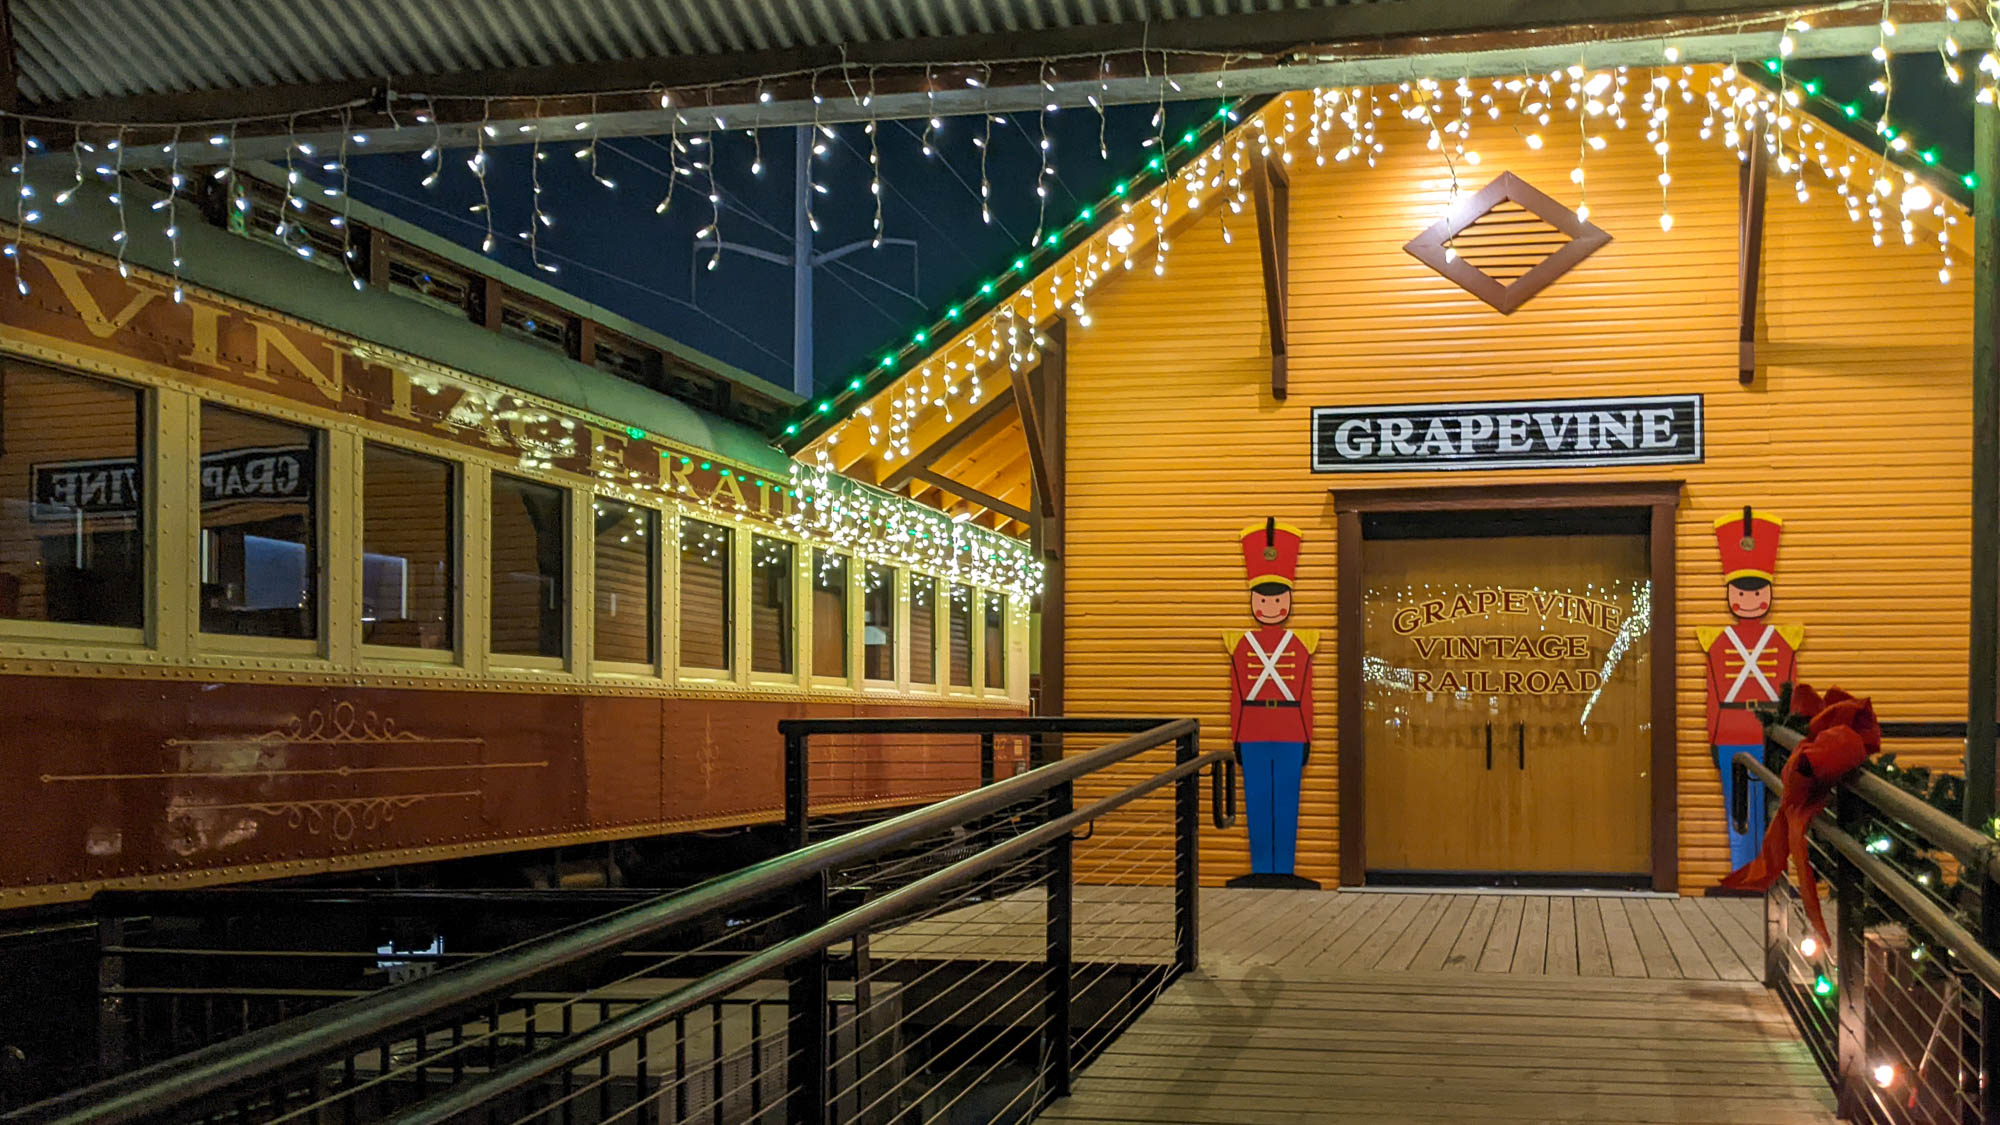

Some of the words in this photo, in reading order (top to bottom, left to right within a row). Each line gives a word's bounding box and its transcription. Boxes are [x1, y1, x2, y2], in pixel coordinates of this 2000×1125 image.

[1334, 408, 1680, 460] GRAPEVINE
[1393, 588, 1622, 636] GRAPEVINE
[1413, 635, 1590, 660] VINTAGE
[1411, 669, 1603, 694] RAILROAD
